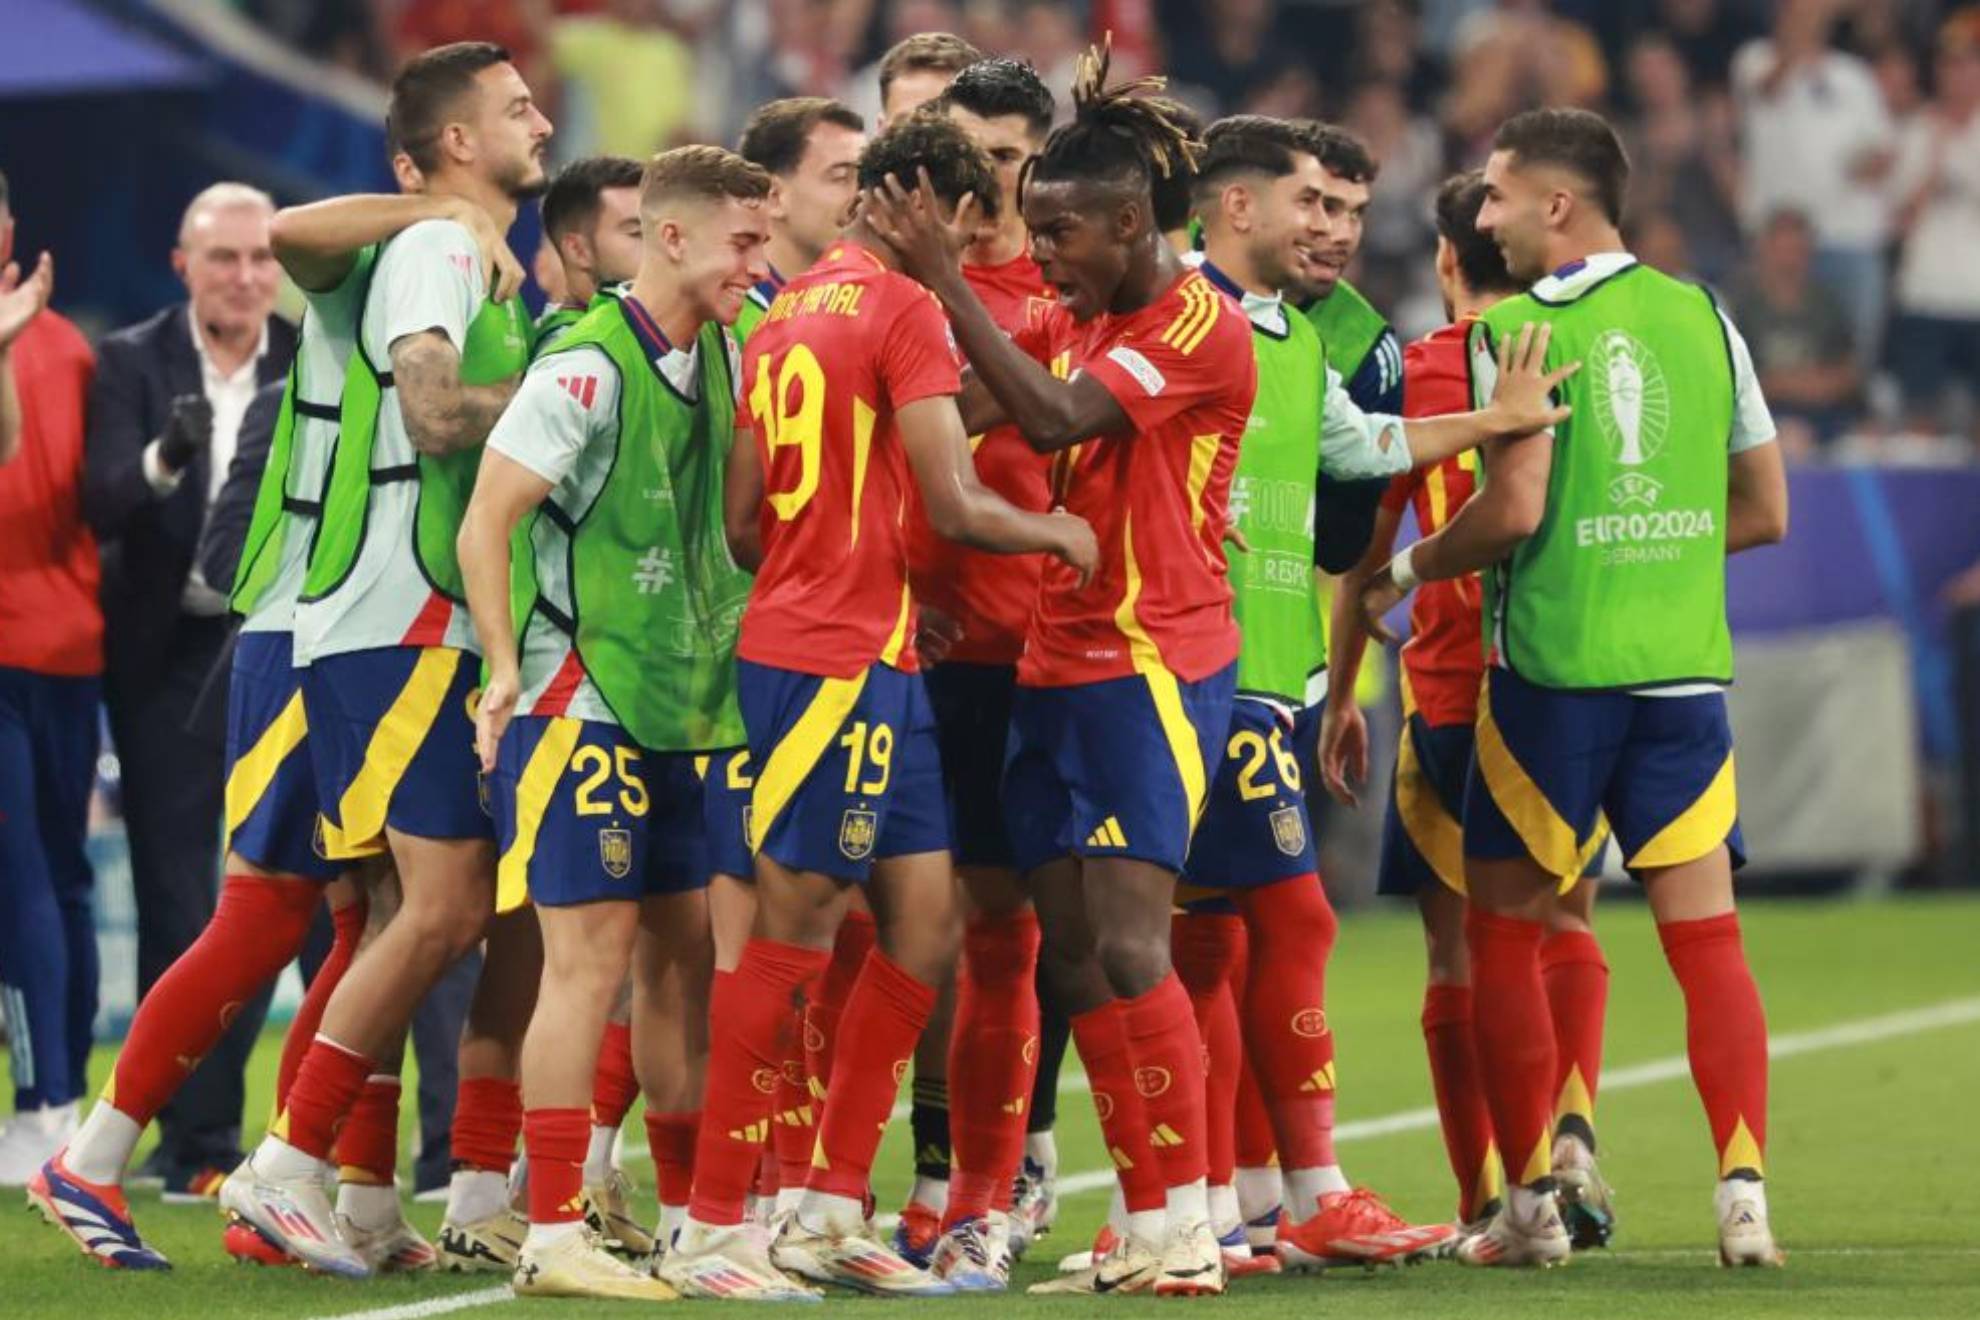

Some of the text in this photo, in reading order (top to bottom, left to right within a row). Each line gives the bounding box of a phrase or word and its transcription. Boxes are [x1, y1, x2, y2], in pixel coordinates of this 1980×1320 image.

[749, 343, 826, 521] 19
[571, 744, 650, 817] 25
[841, 722, 894, 795] 19
[1227, 726, 1301, 801] 26
